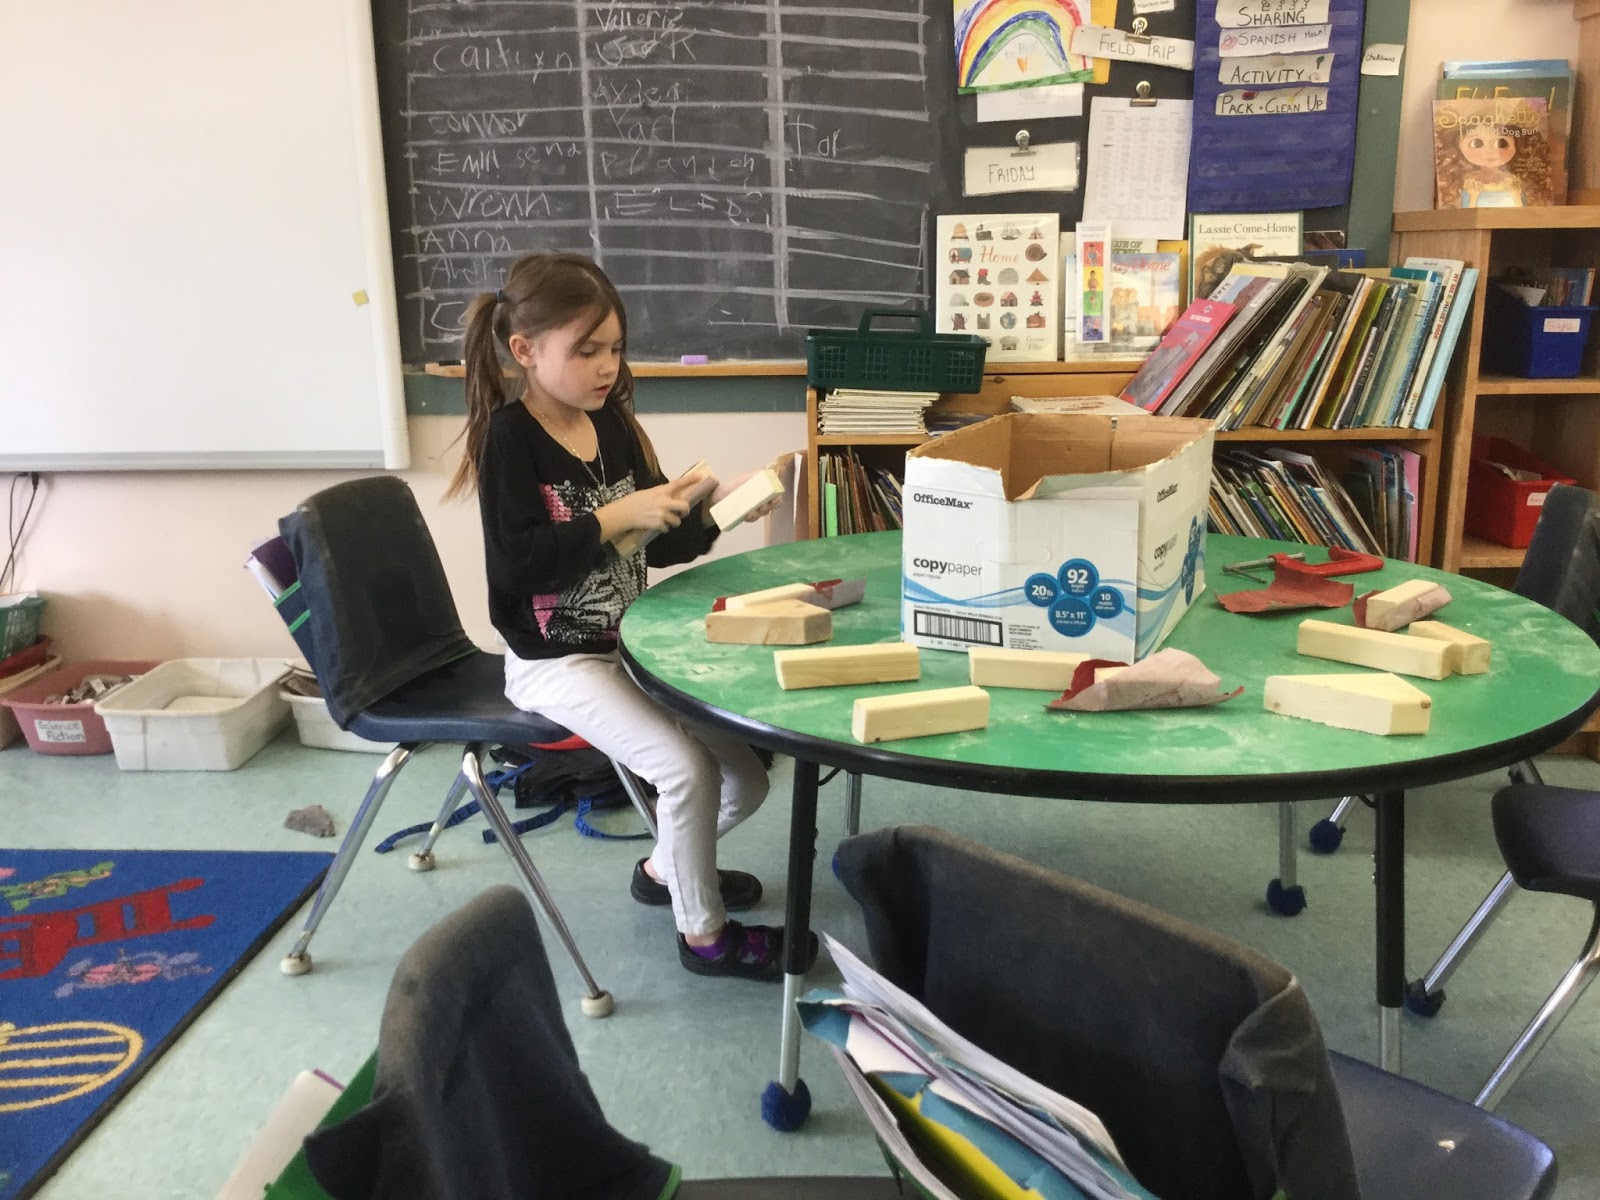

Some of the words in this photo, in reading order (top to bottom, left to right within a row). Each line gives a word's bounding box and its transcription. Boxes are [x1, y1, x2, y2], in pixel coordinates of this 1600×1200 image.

[1237, 6, 1305, 26] SHARING
[1099, 33, 1135, 56] FIELD
[1238, 31, 1297, 46] SPANISH
[1231, 65, 1305, 83] ACTIVITY
[1221, 95, 1254, 114] PACK
[1264, 97, 1301, 113] CLEAN
[1306, 94, 1323, 112] UP
[1501, 127, 1520, 137] Dog
[1521, 128, 1538, 136] Bun
[988, 163, 1035, 184] FRIDAY
[1199, 224, 1232, 234] Lassie
[1233, 223, 1297, 234] Come-Home
[979, 245, 1021, 264] Home
[913, 493, 973, 510] OfficeMax
[1067, 569, 1088, 584] 92
[1100, 593, 1111, 601] 10
[46, 730, 85, 741] Fiction
